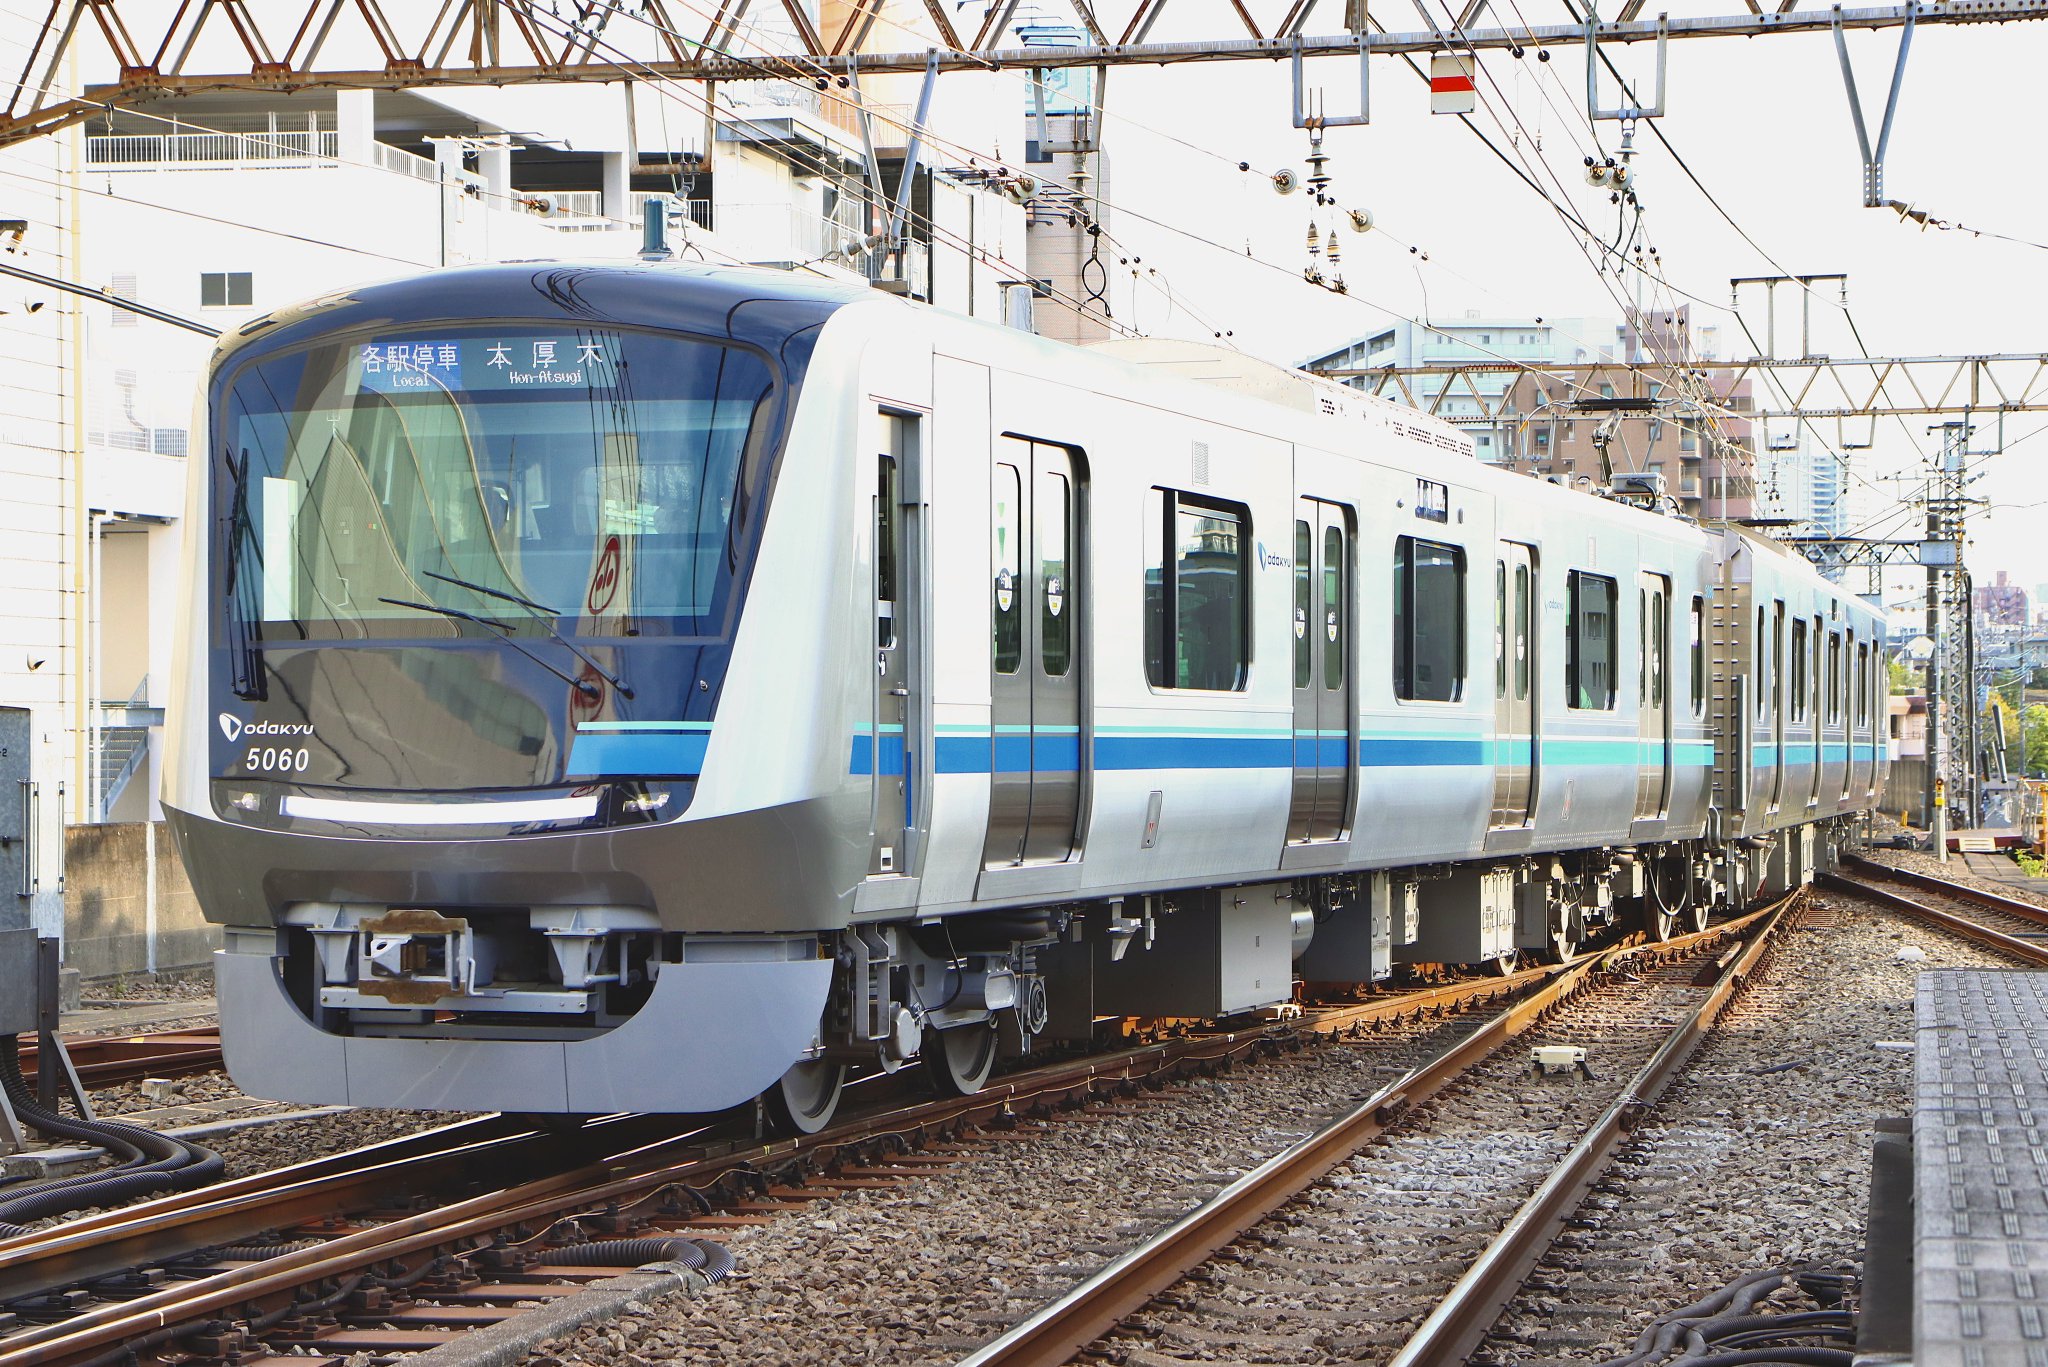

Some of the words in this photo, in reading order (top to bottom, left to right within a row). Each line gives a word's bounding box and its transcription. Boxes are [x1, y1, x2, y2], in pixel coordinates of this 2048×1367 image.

[362, 343, 459, 374] 各駅停車
[486, 339, 603, 370] 本厚木
[392, 374, 430, 387] Local
[509, 369, 582, 386] Hon-Atsugi
[244, 720, 314, 735] odakyu
[246, 747, 309, 772] 5060
